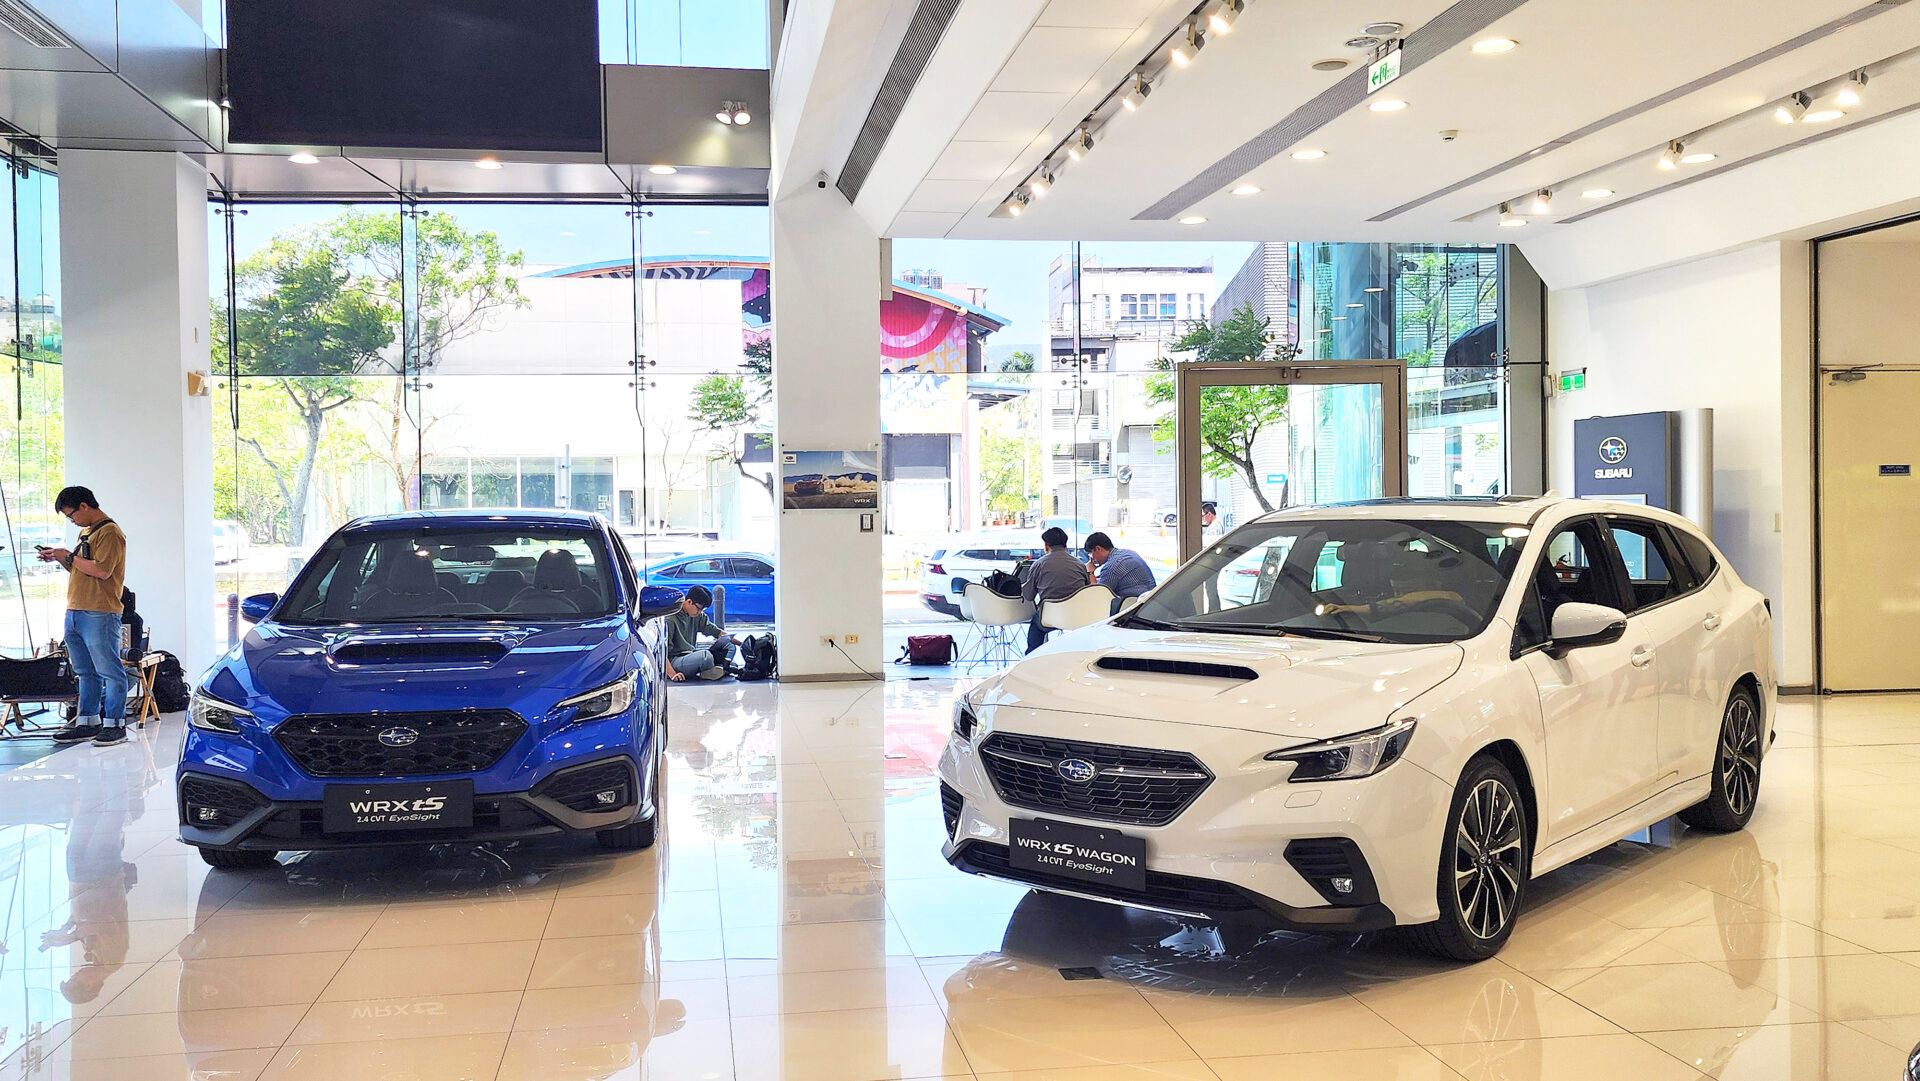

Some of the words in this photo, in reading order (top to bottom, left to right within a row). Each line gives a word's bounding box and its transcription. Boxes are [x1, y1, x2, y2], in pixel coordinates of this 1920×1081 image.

[1595, 468, 1633, 479] SUBARU
[349, 800, 410, 813] WRX
[411, 796, 448, 811] tS
[388, 813, 441, 823] EyeSight
[1017, 837, 1052, 852] WRX
[1053, 843, 1075, 855] tS
[1076, 847, 1136, 867] WAGON
[1037, 854, 1048, 863] 2.4
[1049, 856, 1064, 866] CVT
[1065, 860, 1114, 875] EyeSight
